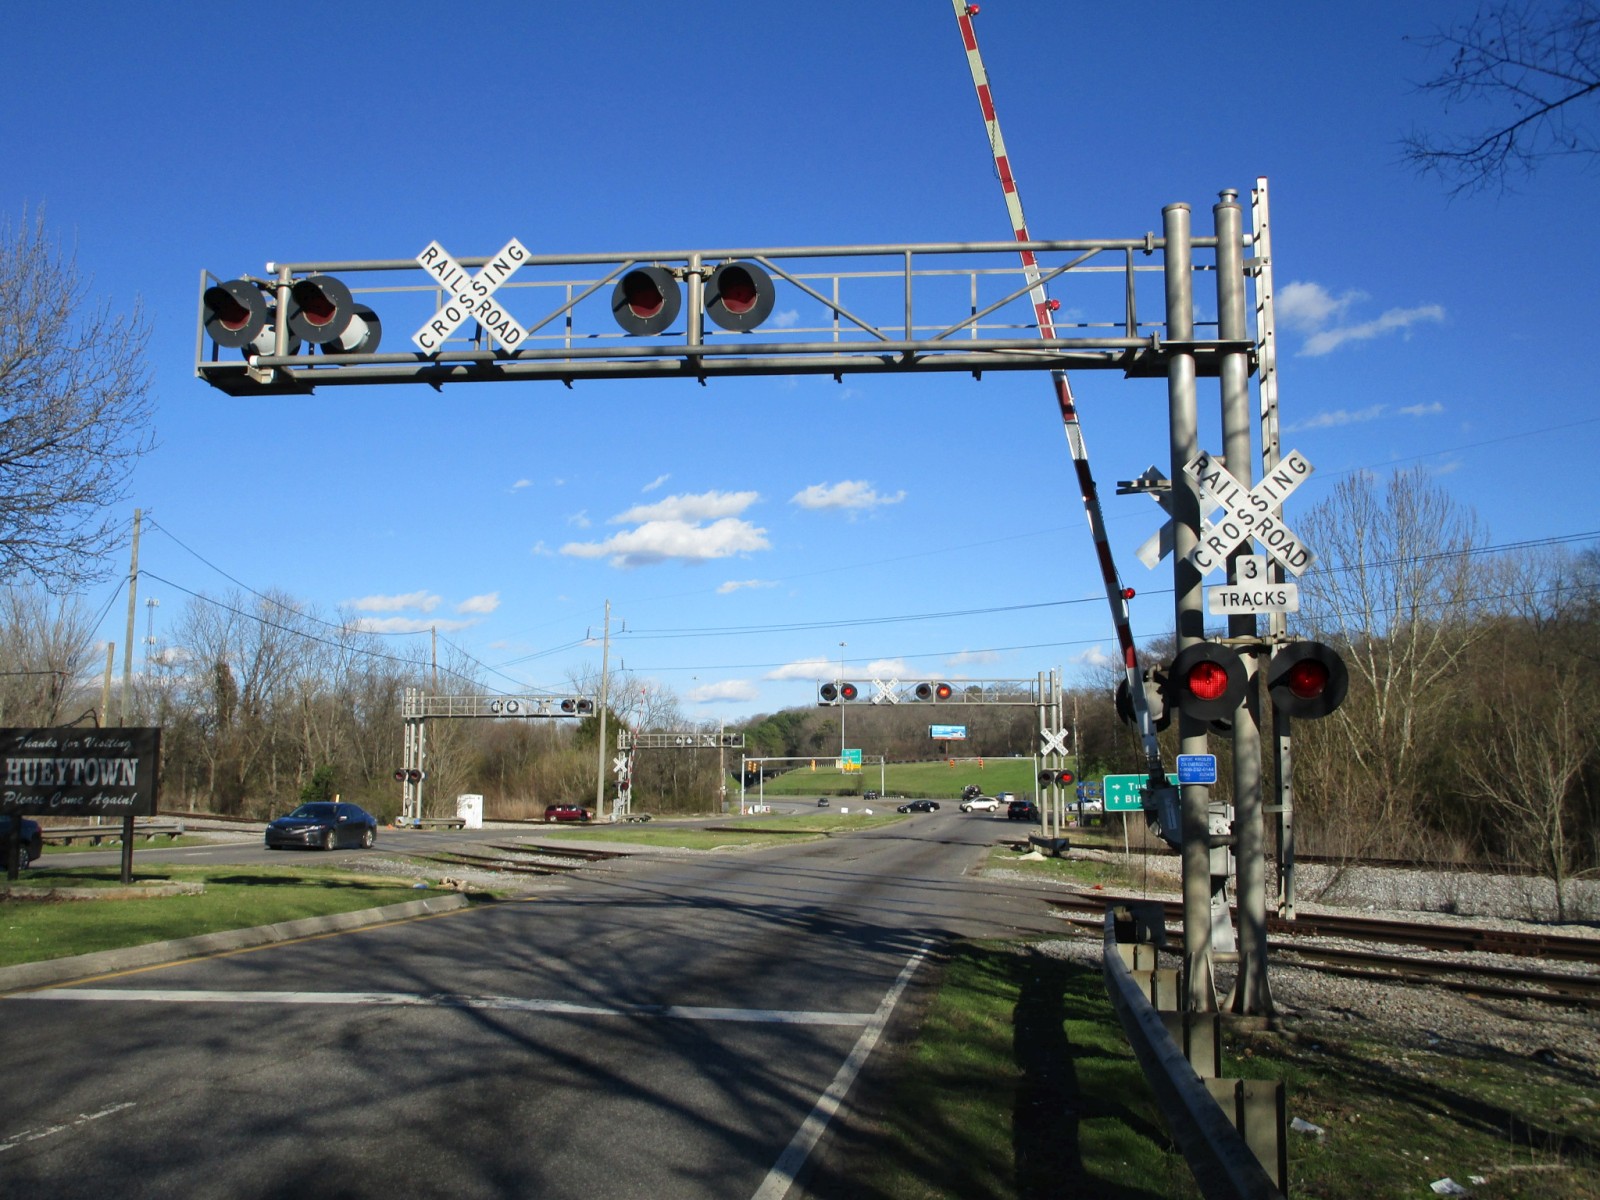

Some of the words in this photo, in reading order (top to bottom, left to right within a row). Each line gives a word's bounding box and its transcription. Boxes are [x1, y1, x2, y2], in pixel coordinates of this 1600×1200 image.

[419, 245, 524, 349] CROSSING
[421, 246, 463, 293] RAIL
[475, 299, 520, 345] ROAD
[1190, 455, 1239, 508] RAIL
[1255, 516, 1307, 568] ROAD
[1194, 456, 1306, 568] CROSSING
[1245, 559, 1258, 579] 3
[1220, 591, 1287, 607] TRACKS
[15, 736, 58, 750] Thanks
[62, 738, 80, 751] for
[84, 736, 132, 752] Visiting
[5, 757, 139, 786] HUEYTOWN
[3, 790, 44, 806] Please
[50, 791, 83, 808] Come
[88, 792, 138, 809] Again!
